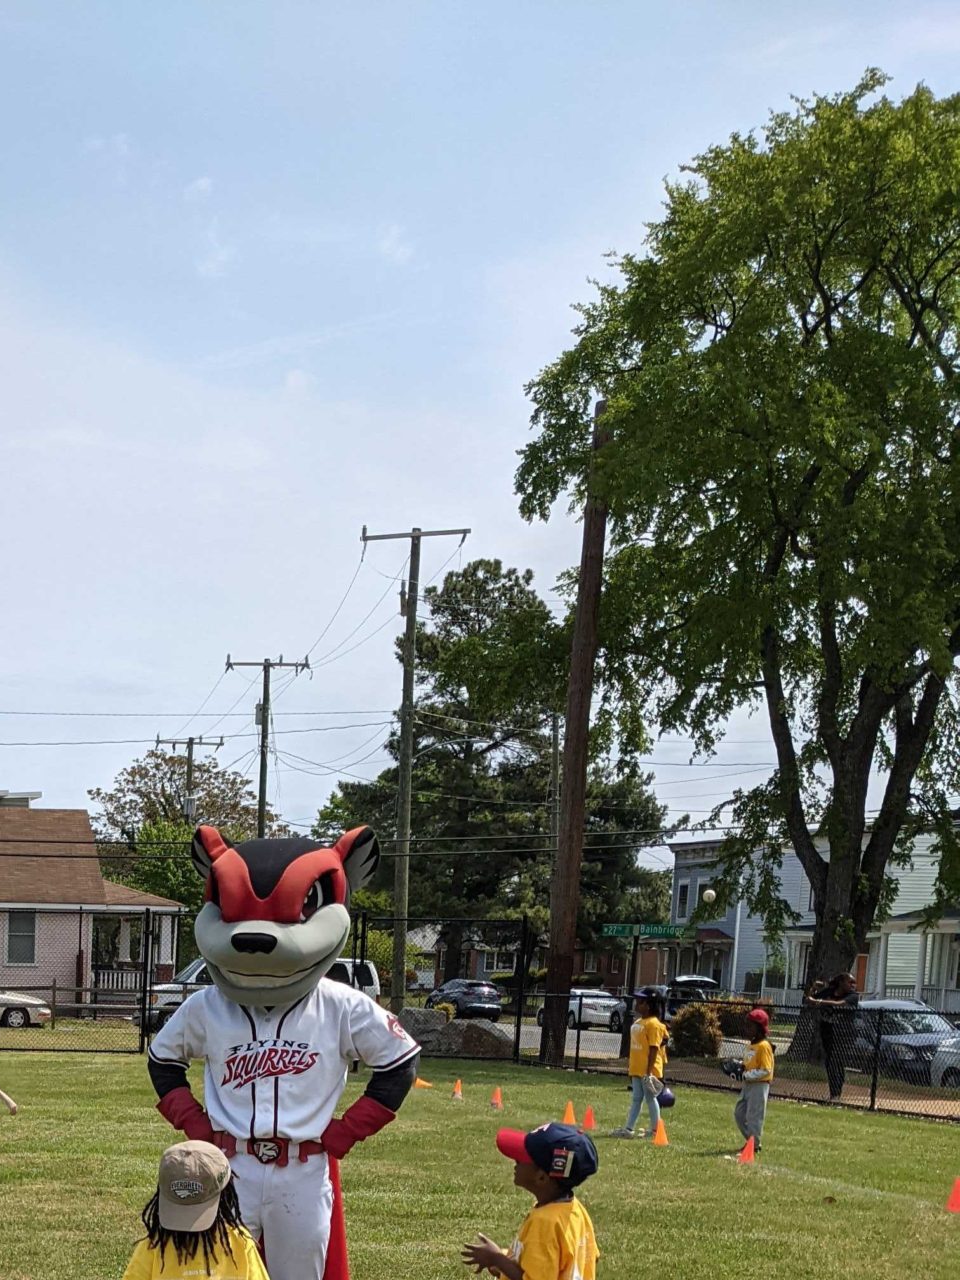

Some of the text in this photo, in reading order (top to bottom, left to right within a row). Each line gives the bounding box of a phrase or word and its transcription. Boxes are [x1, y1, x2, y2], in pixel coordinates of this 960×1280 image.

[640, 924, 685, 936] Bainbridge
[228, 1040, 309, 1058] FLYING
[221, 1048, 320, 1089] SQUIRRELS
